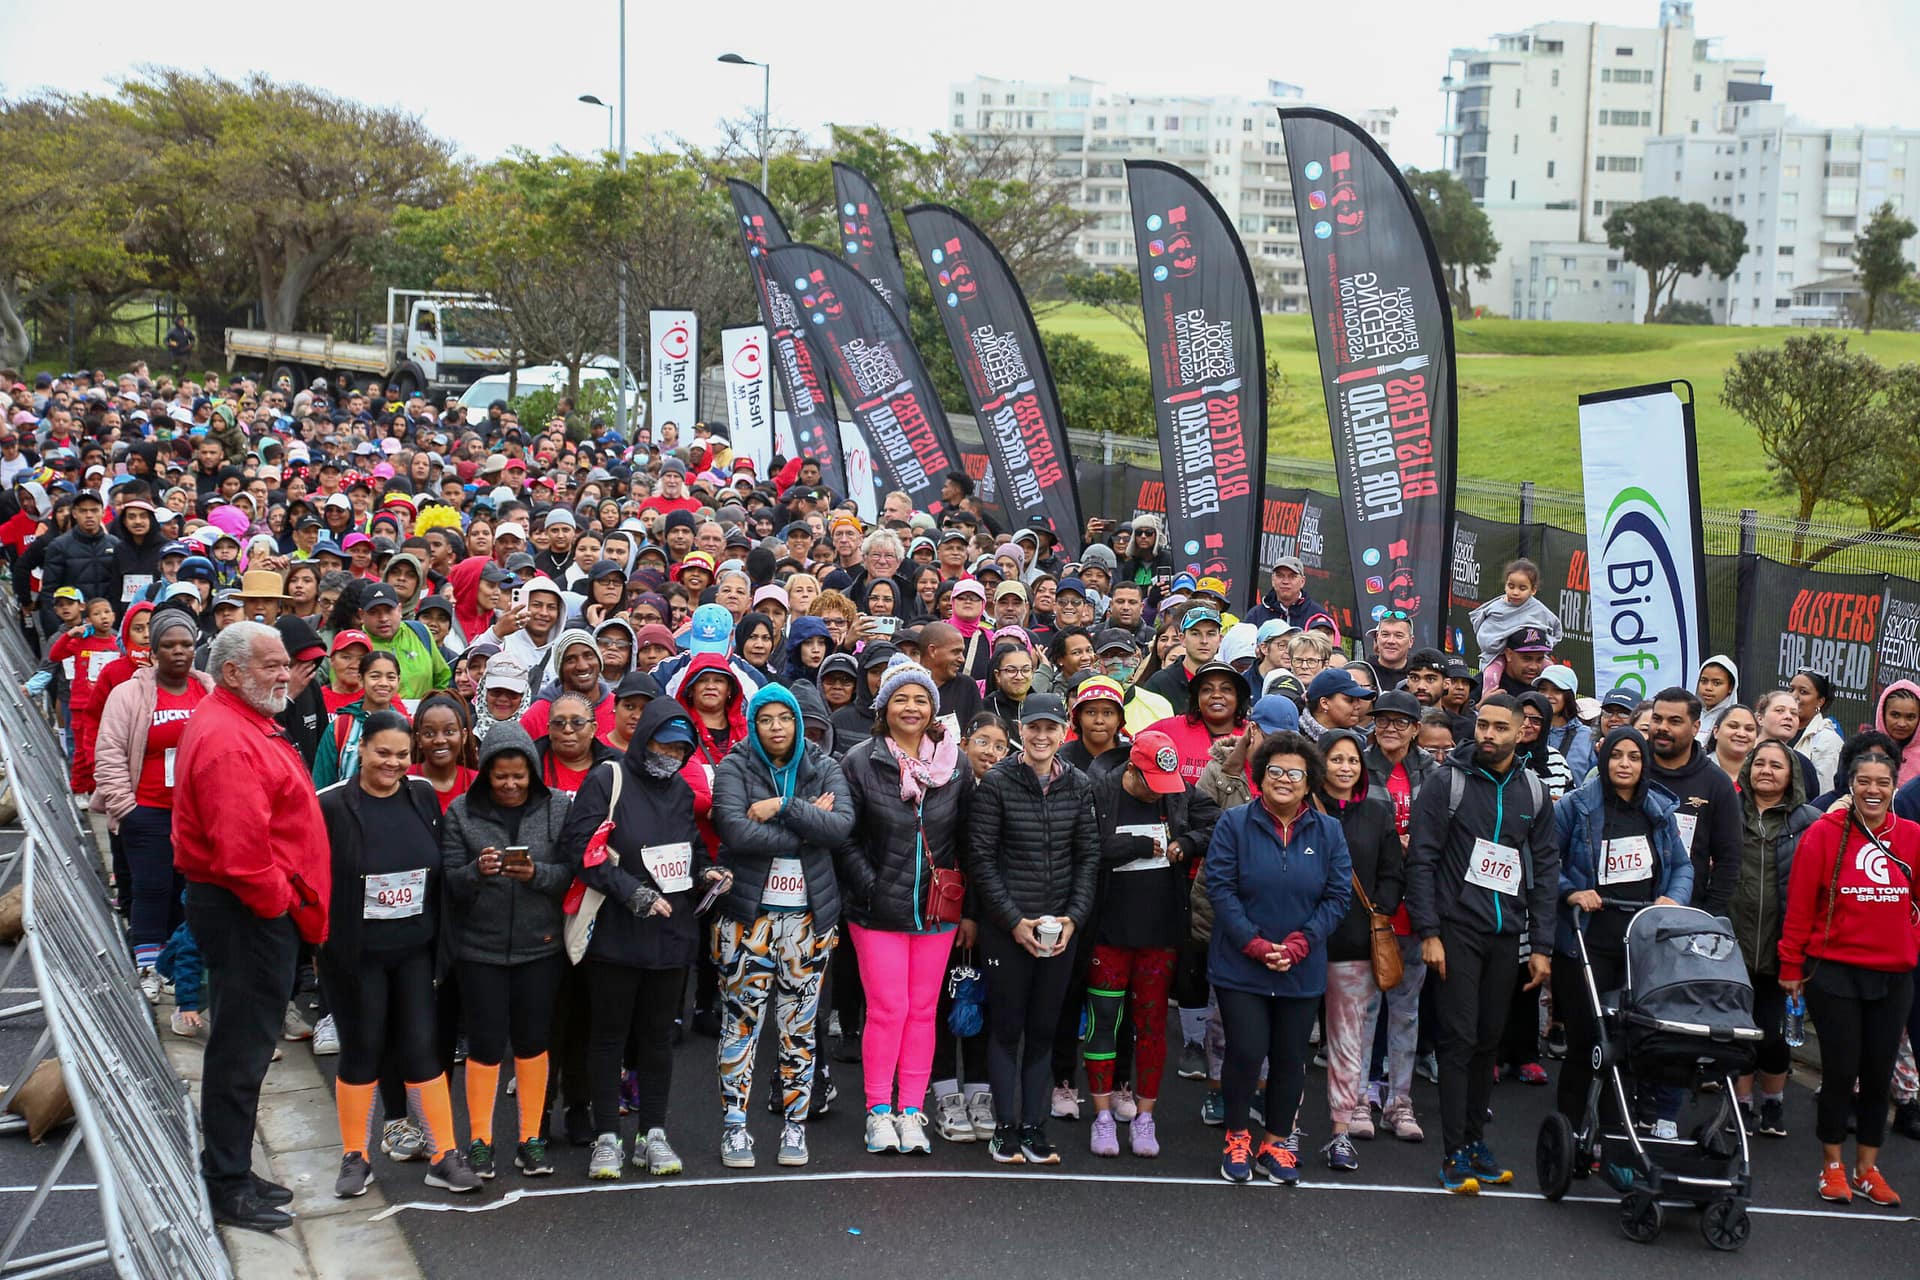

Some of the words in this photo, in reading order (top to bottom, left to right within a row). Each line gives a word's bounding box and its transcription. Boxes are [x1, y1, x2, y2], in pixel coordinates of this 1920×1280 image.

[1454, 541, 1475, 562] SCHOOL
[1452, 559, 1480, 585] FEEDING
[1559, 589, 1581, 631] FOR
[1787, 588, 1882, 643] BLISTERS
[1885, 614, 1920, 642] SCHOOL
[1778, 632, 1806, 679] FOR
[1810, 638, 1871, 690] BREAD
[1845, 691, 1867, 701] WALK
[153, 709, 190, 726] LUCKY
[1481, 858, 1512, 879] 9176
[1607, 853, 1642, 870] 9175
[378, 887, 412, 906] 9349
[1840, 886, 1874, 895] CAPE
[1856, 894, 1900, 902] SPURS
